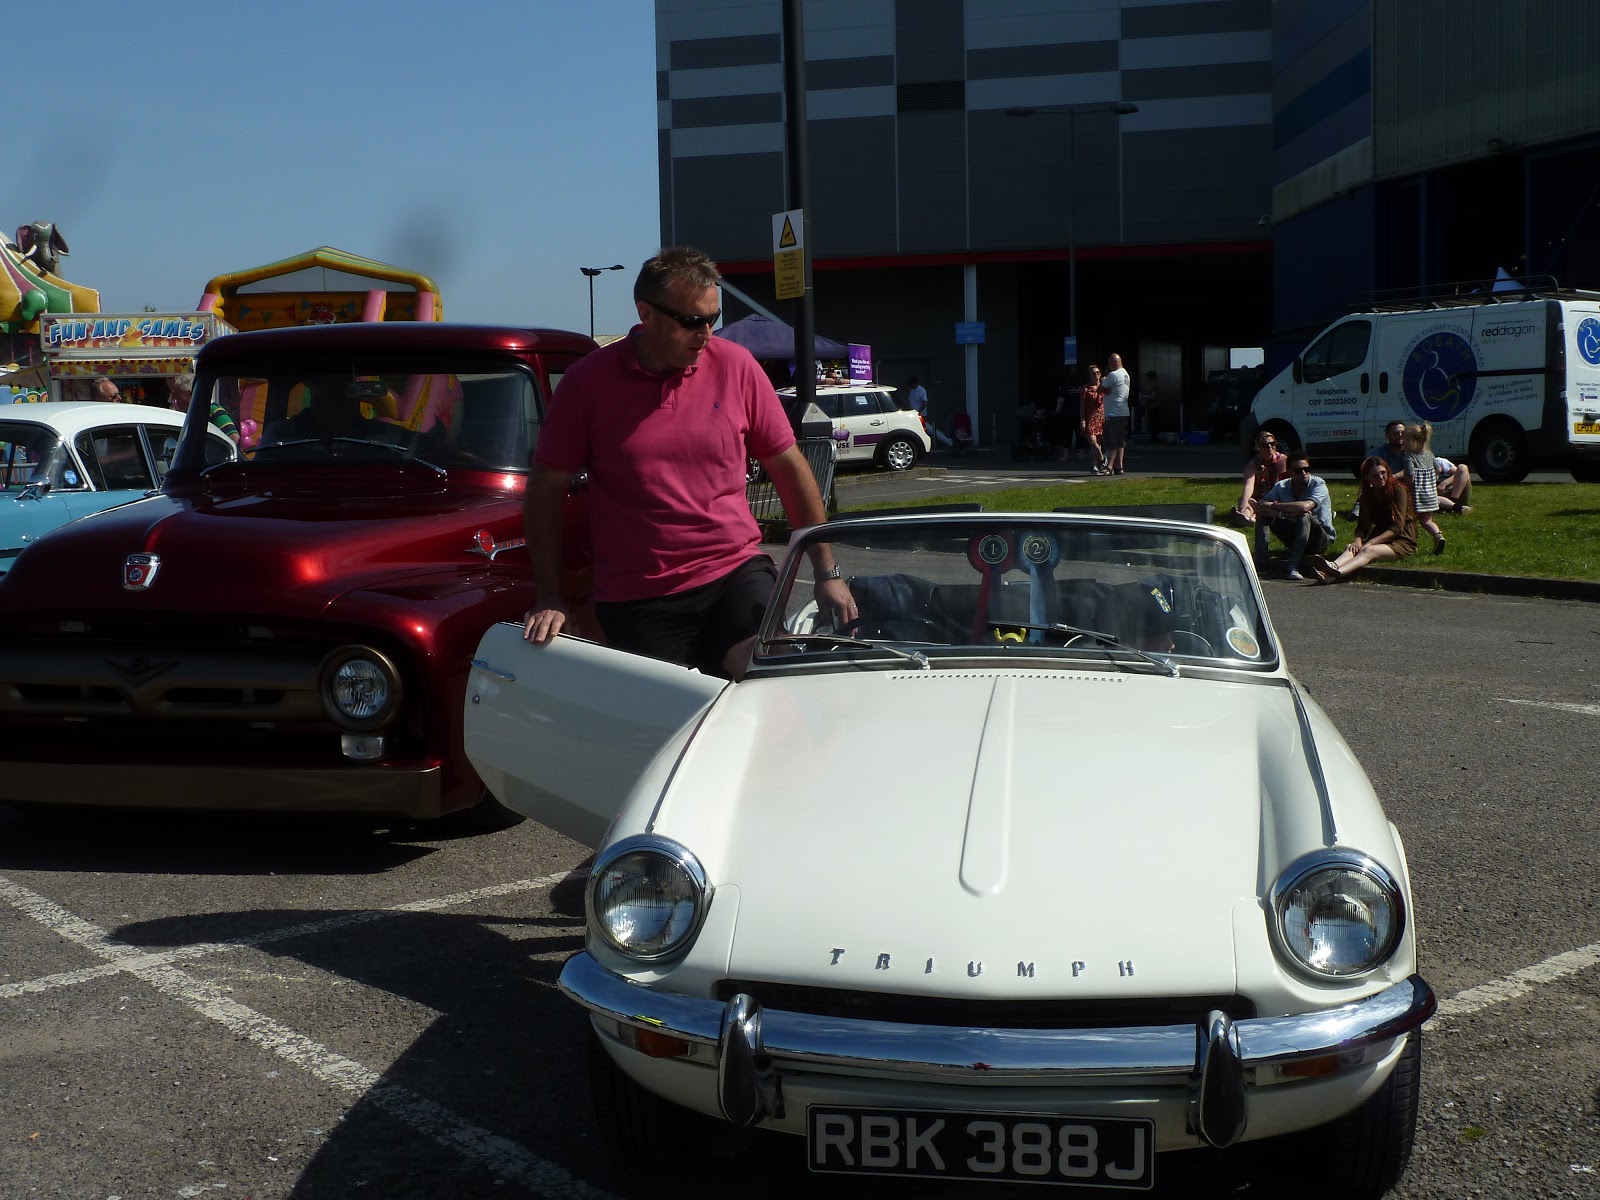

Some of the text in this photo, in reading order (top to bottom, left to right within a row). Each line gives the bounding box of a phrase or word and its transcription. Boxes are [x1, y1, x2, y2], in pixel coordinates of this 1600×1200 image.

[50, 321, 87, 344] FUN
[92, 319, 131, 339] AND
[137, 319, 206, 341] GAMES
[1422, 323, 1452, 336] THERAPY
[1473, 341, 1485, 368] WALES
[1481, 325, 1535, 338] reddragon
[1411, 336, 1471, 362] BOBATH
[829, 948, 1135, 978] TRIUMPH
[815, 1113, 1145, 1181] RBK 388J
